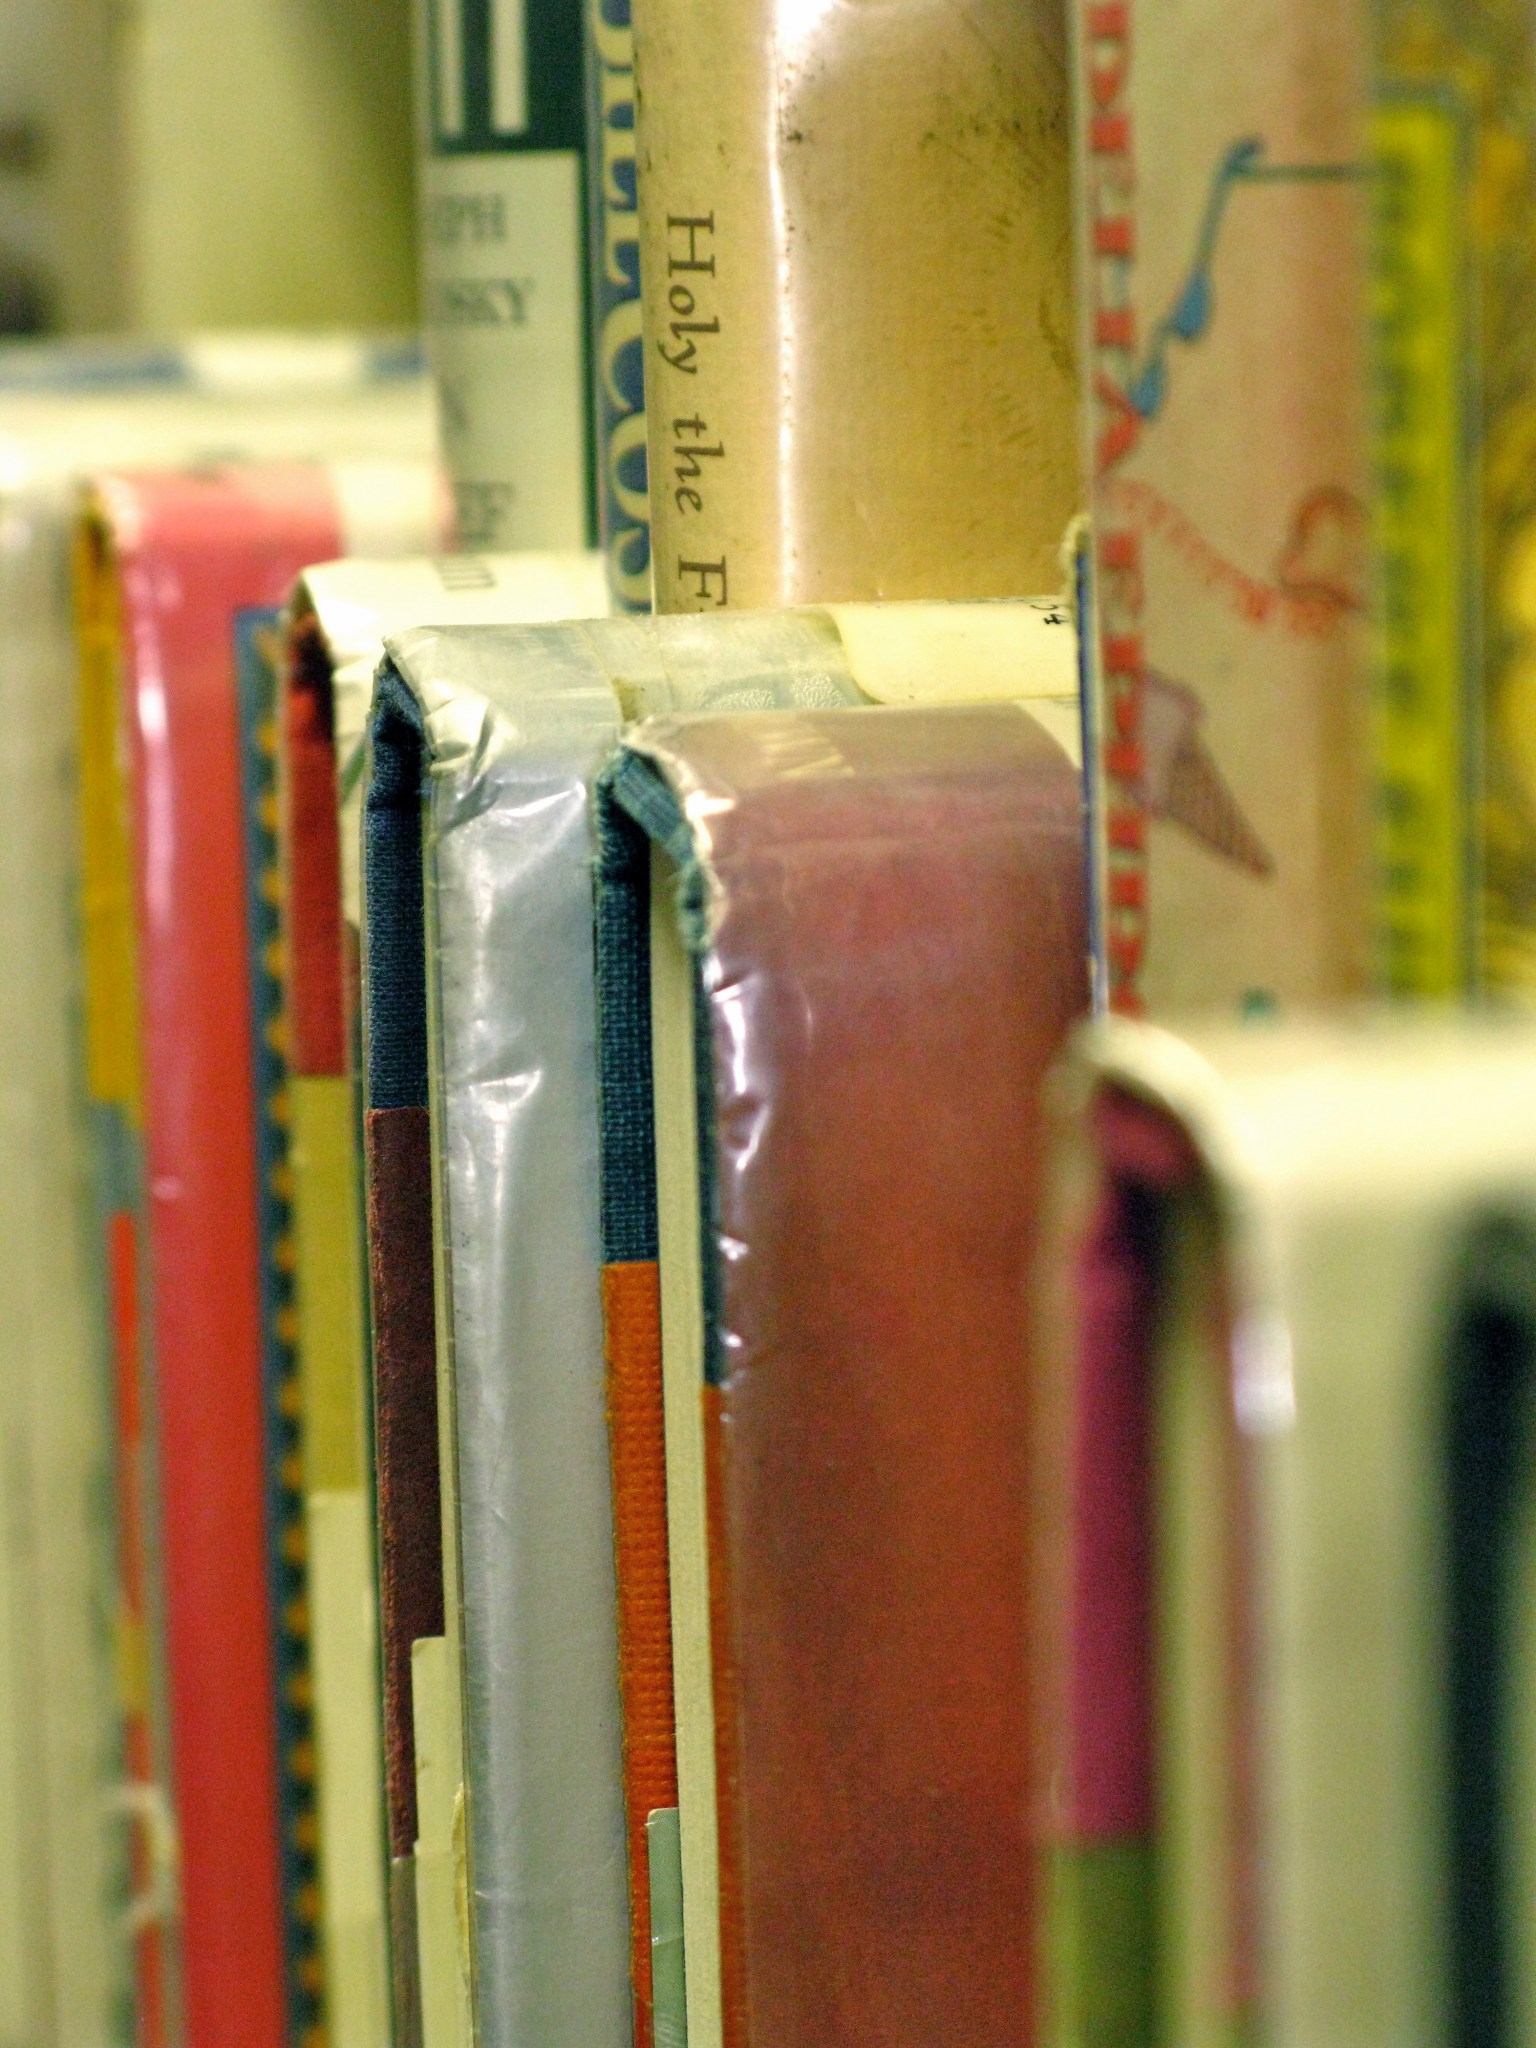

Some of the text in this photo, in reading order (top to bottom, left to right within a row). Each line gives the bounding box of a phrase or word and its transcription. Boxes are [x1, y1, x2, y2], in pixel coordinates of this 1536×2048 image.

[656, 210, 728, 613] Holy the F
